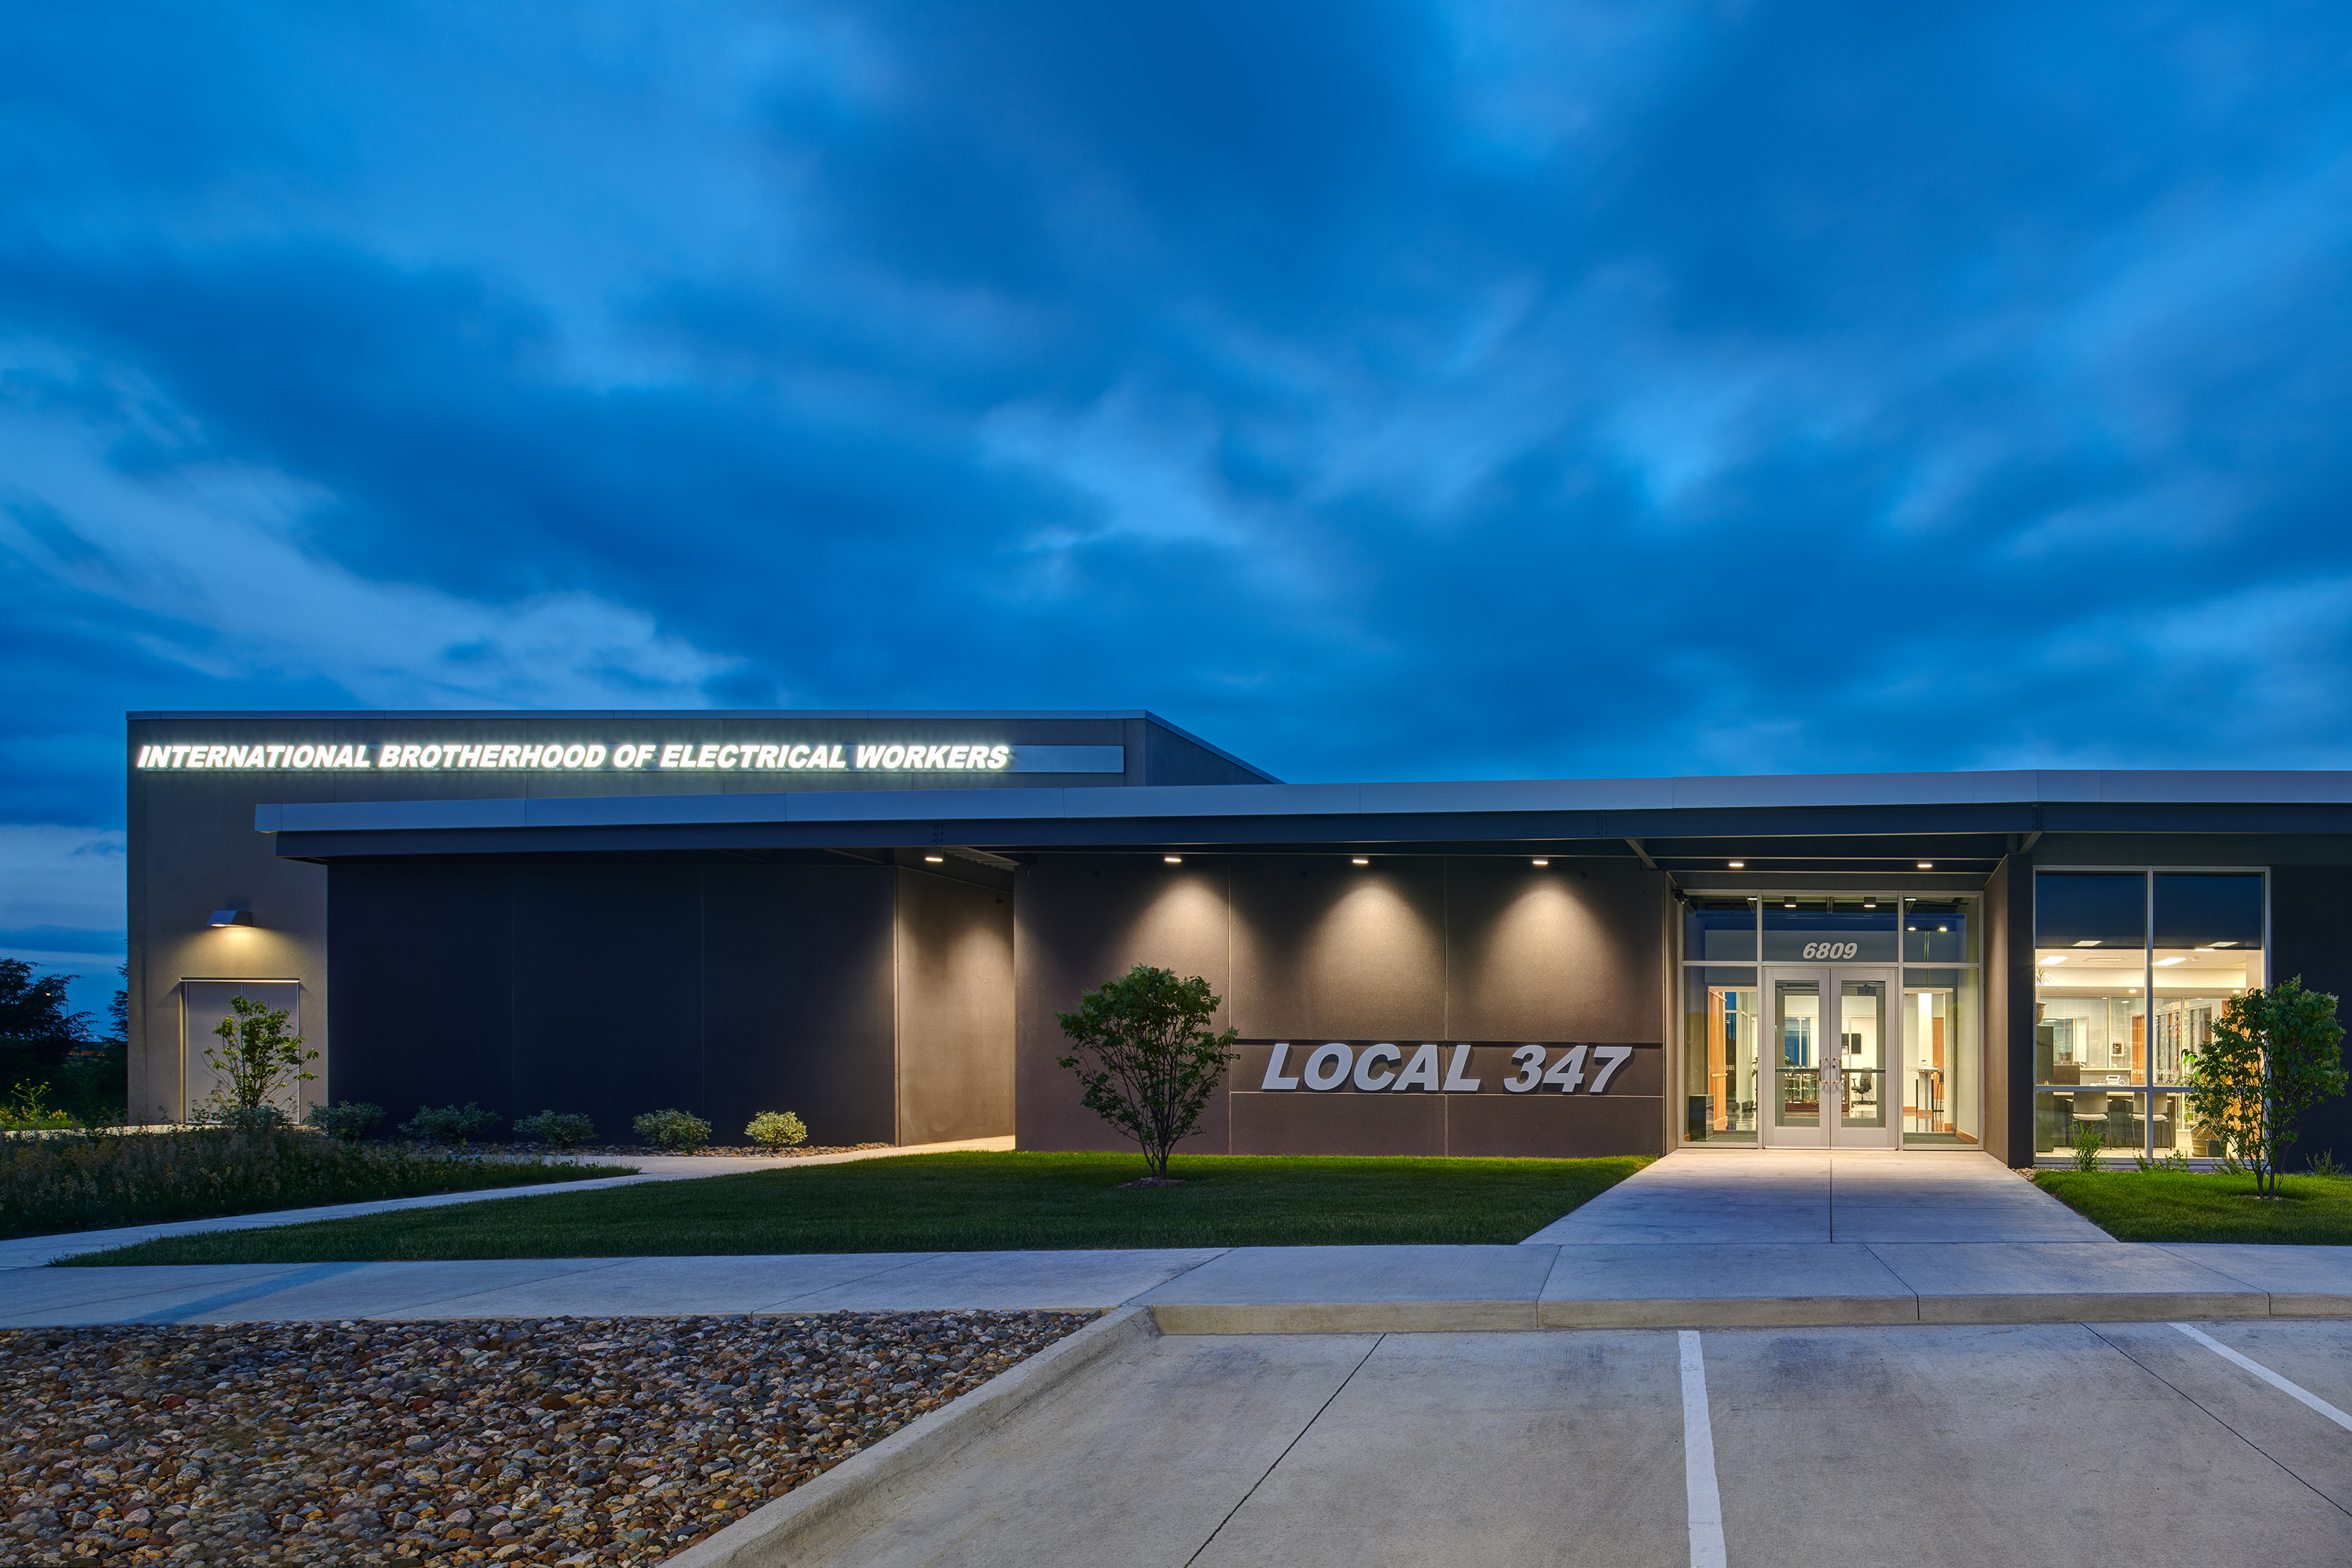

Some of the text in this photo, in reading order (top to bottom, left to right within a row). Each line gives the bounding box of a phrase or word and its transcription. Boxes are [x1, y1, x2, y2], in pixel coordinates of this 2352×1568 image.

[137, 745, 1010, 769] INTERNATIONAL BROTHERHOOD OF ELECTRICAL WORKERS
[1802, 942, 1858, 960] 6809
[1261, 1042, 1633, 1093] LOCAL 347
